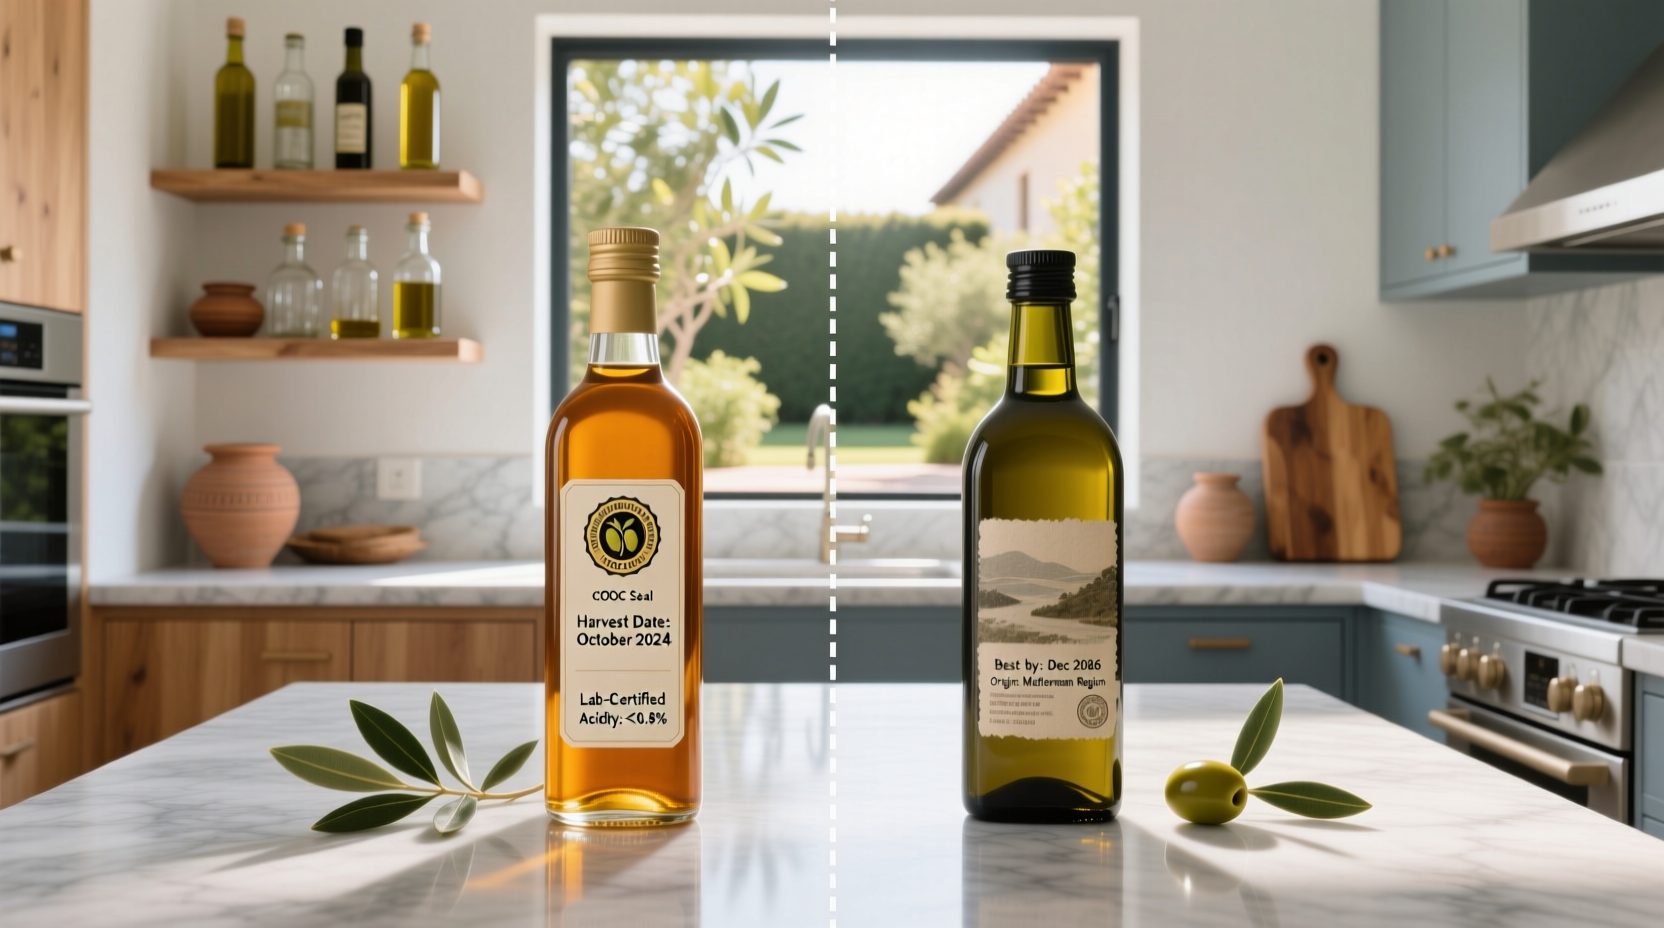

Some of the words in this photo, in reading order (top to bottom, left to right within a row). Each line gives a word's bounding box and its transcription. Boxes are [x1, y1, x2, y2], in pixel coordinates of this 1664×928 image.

[592, 590, 626, 601] COOC
[577, 614, 629, 628] Harvest
[633, 615, 670, 628] Date:
[577, 632, 632, 646] October
[635, 632, 672, 646] 2024
[995, 658, 1020, 671] Best
[1025, 658, 1043, 674] by:
[1048, 659, 1070, 671] Dec
[580, 691, 666, 706] Lab-Certified
